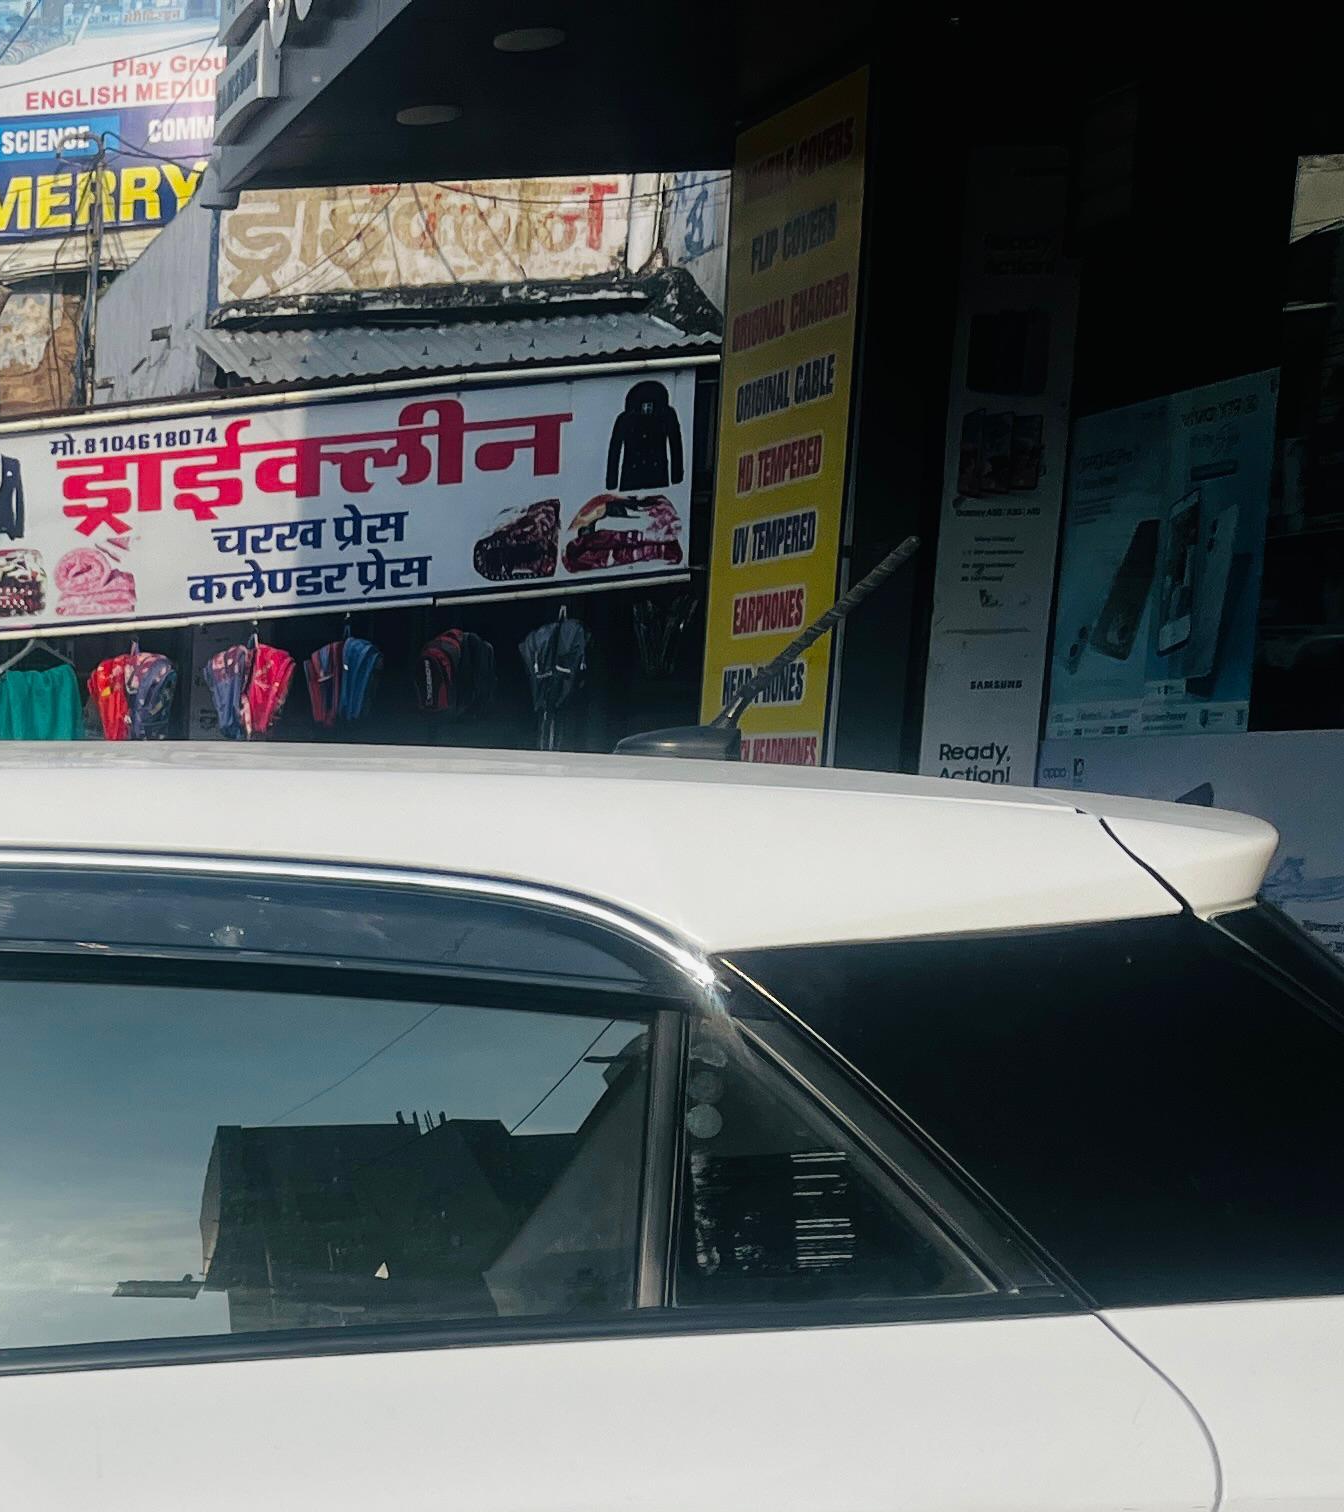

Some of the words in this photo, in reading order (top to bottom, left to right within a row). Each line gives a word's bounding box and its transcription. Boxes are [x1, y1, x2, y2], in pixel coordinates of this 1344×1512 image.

[112, 59, 161, 79] Play
[25, 84, 127, 110] ENGLISH
[135, 77, 217, 102] MEDIU
[0, 124, 91, 154] SCIENCE
[799, 117, 855, 177] COVERS
[751, 229, 779, 275] FLIP
[782, 201, 838, 261] COVERS
[732, 298, 786, 352] ORIGINAL
[789, 272, 850, 332] CHARGER
[736, 370, 790, 423] ORIGINAL
[794, 354, 836, 405] CABLE
[56, 399, 574, 538] ड्राईक्लीन
[737, 455, 753, 494] HD
[757, 434, 822, 489] TEMPERED
[334, 504, 409, 551] प्रेस
[732, 526, 750, 565] UV
[752, 510, 816, 560] TEMPERED
[356, 549, 432, 596] प्रेस
[732, 588, 805, 636] EARPHONES
[969, 680, 1023, 690] SAMSUNG
[939, 742, 1012, 767] Ready,
[939, 766, 1012, 784] Action!
